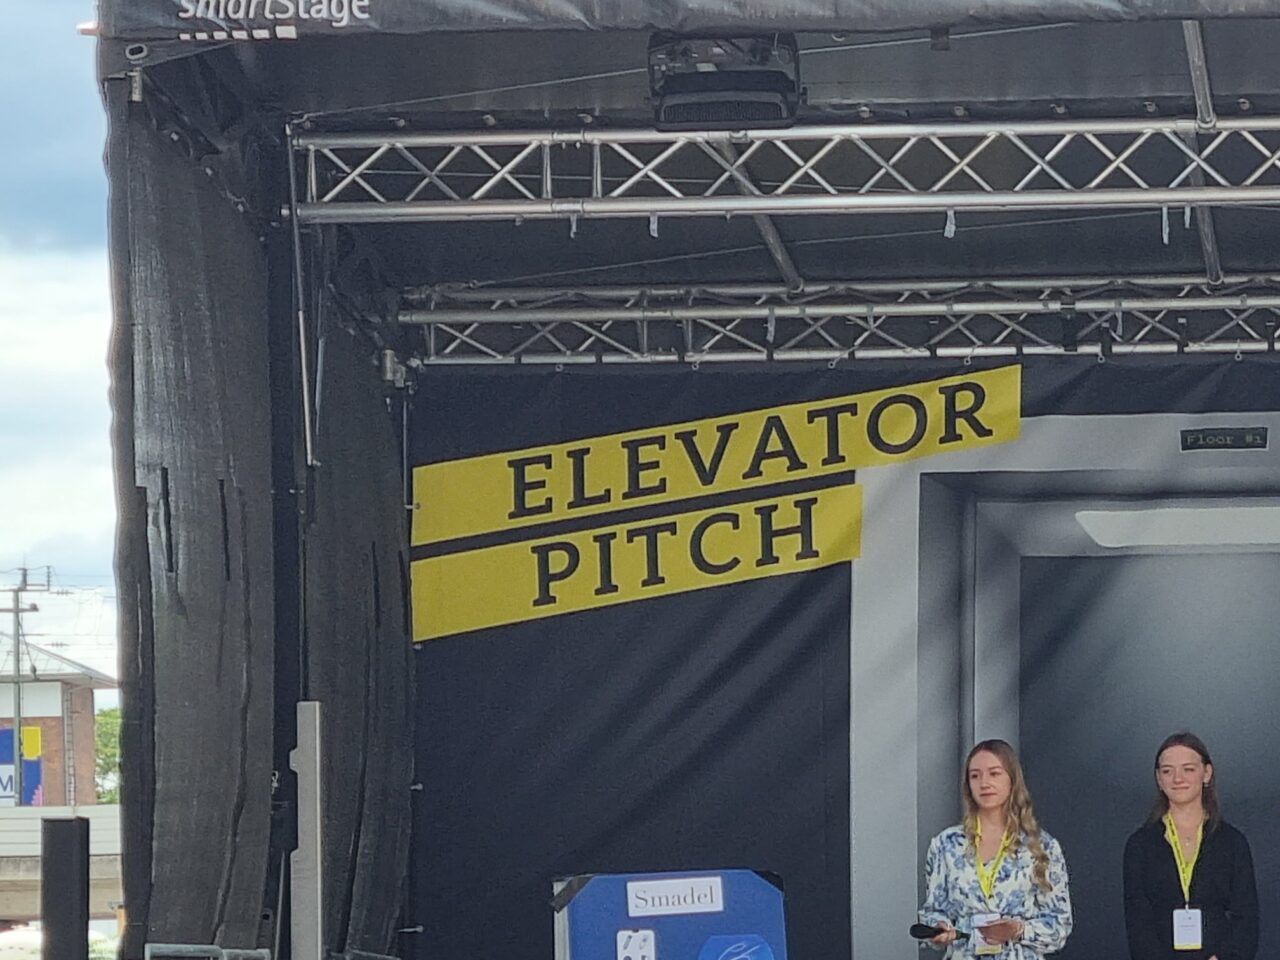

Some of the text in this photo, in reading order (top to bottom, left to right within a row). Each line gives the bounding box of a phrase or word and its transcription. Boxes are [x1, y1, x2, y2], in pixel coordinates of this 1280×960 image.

[507, 380, 994, 520] ELEVATOR
[1187, 434, 1234, 446] Floor
[530, 496, 820, 607] PITCH
[634, 885, 715, 909] Smadel
